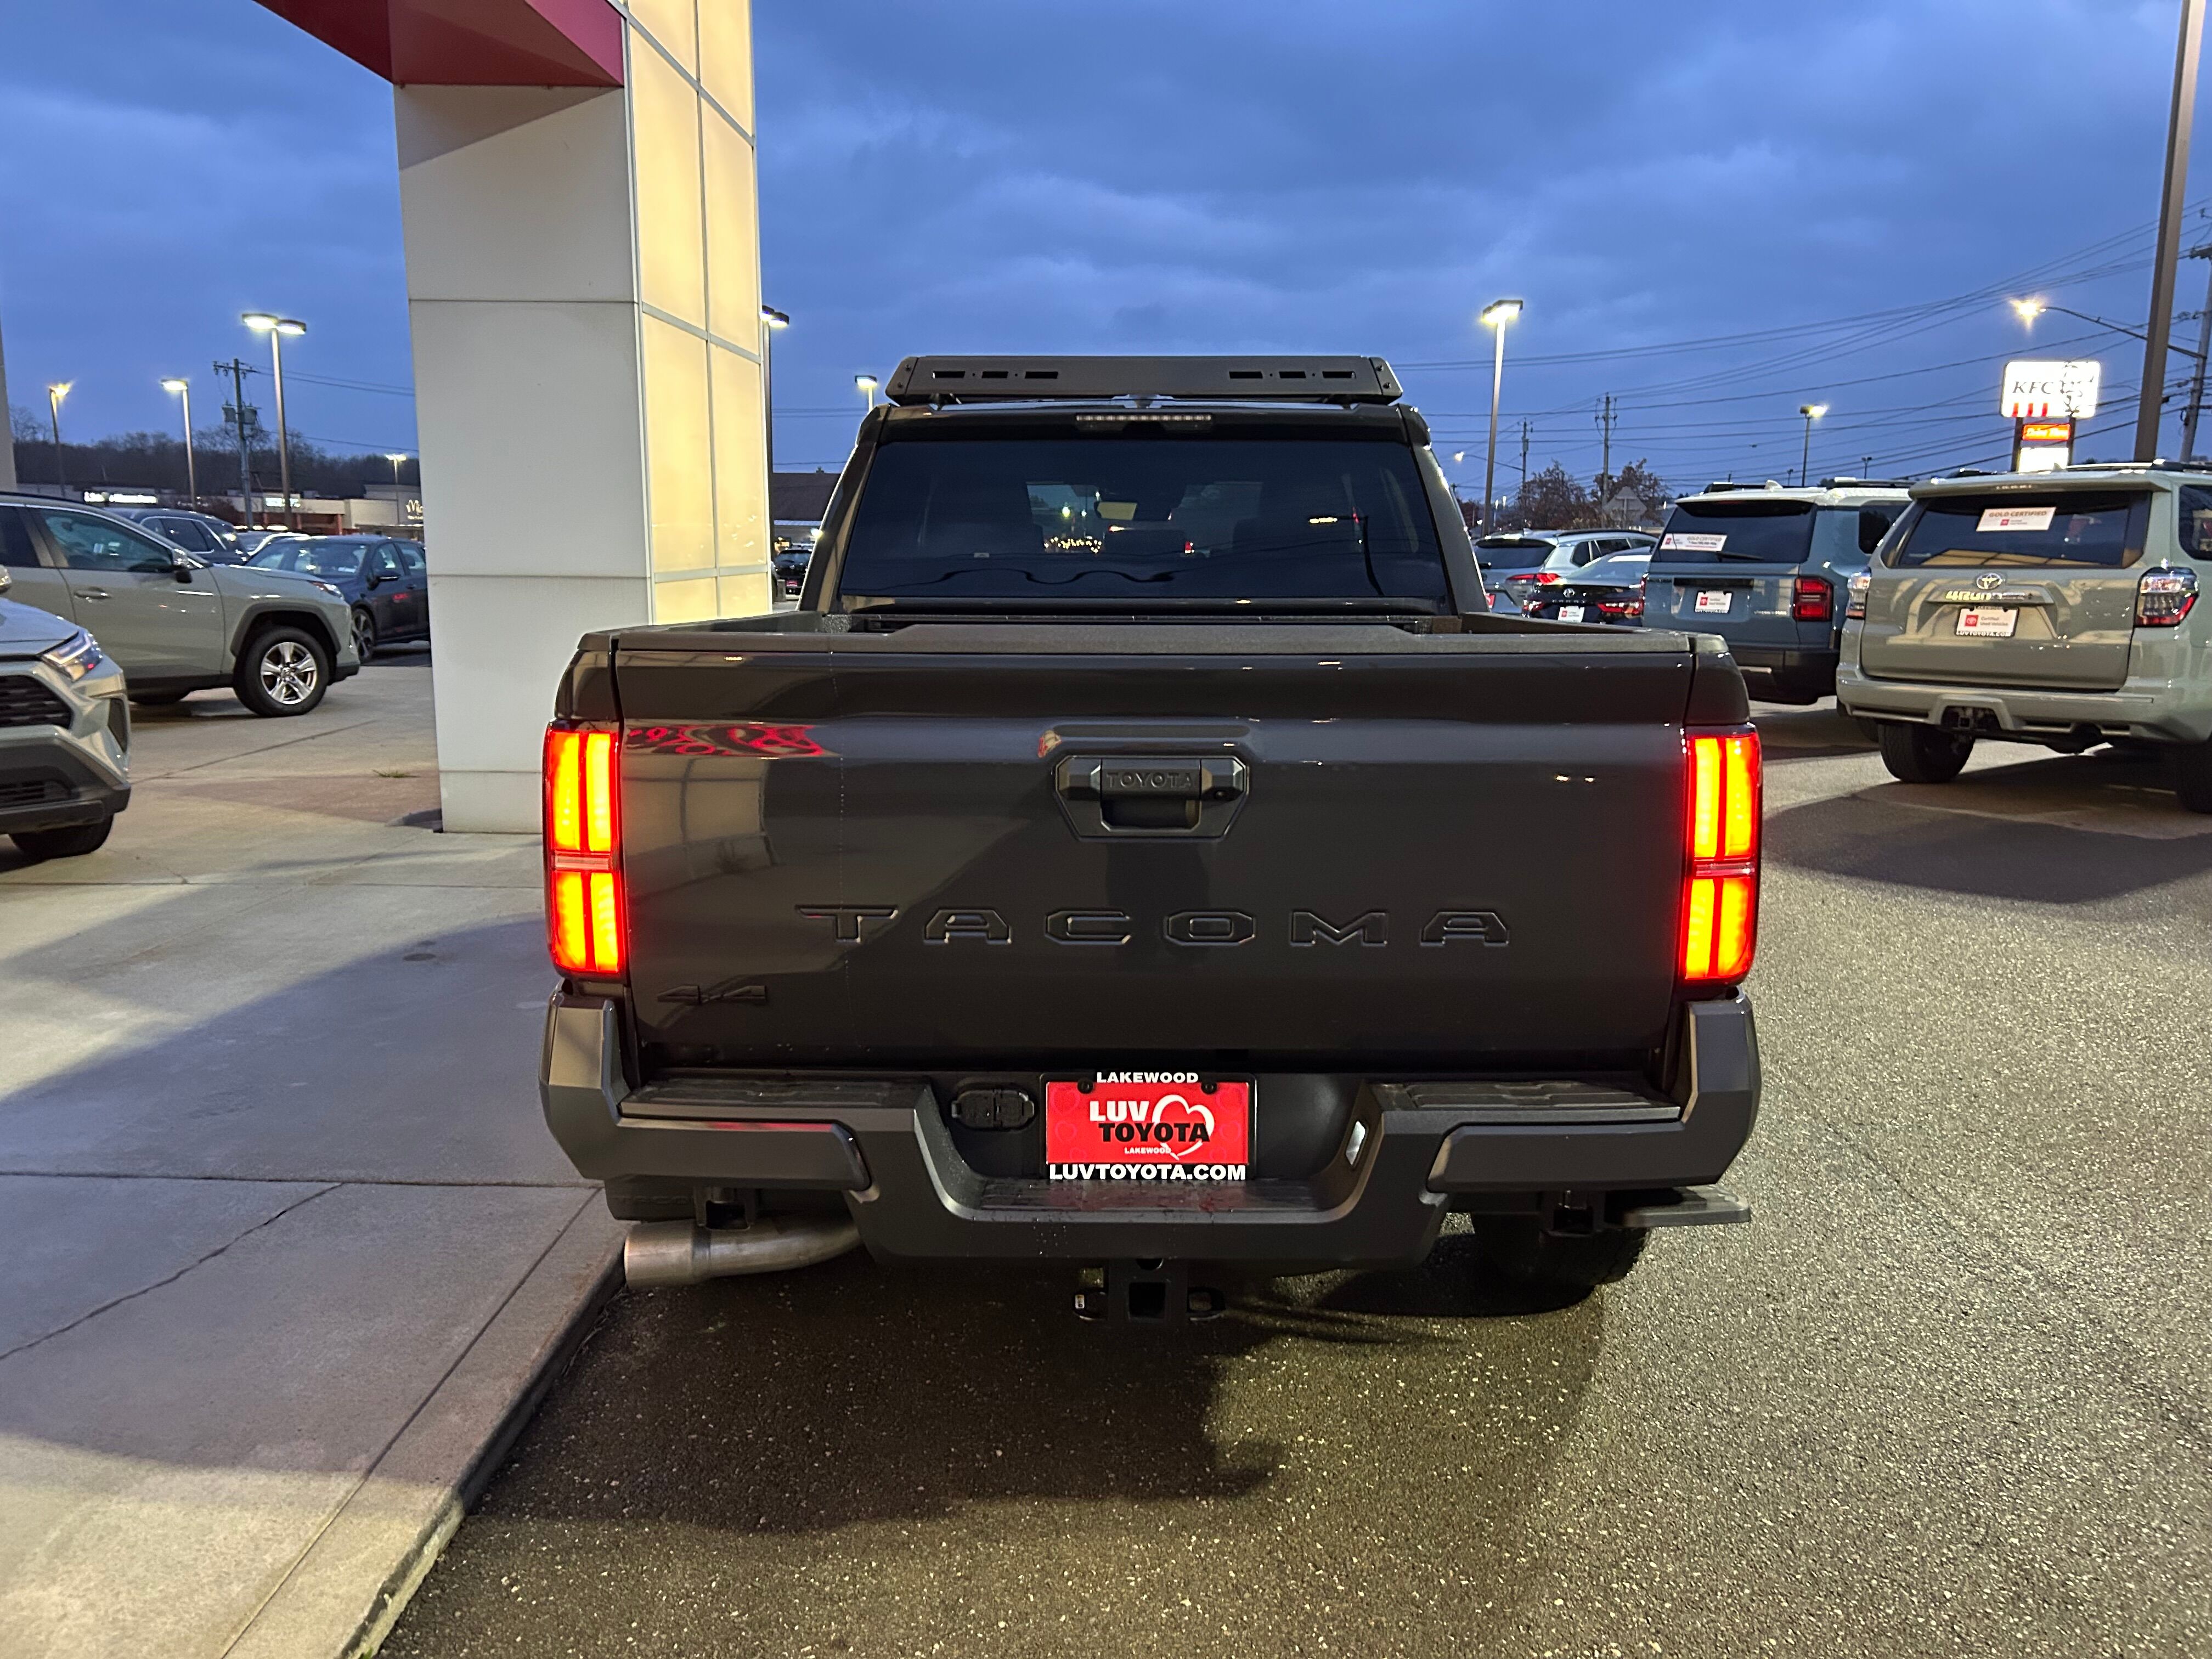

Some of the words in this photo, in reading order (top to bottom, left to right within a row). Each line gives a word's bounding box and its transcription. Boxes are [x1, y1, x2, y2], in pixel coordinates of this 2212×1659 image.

[2012, 381, 2054, 394] KFC
[1106, 772, 1194, 788] TOYOTA
[795, 905, 1510, 946] TACOMA
[1097, 1071, 1199, 1084] LAKEWOOD
[1090, 1101, 1150, 1122] LUV
[1098, 1122, 1210, 1142] TOYOTA
[1049, 1164, 1246, 1180] LUVTOYOTA.COM
